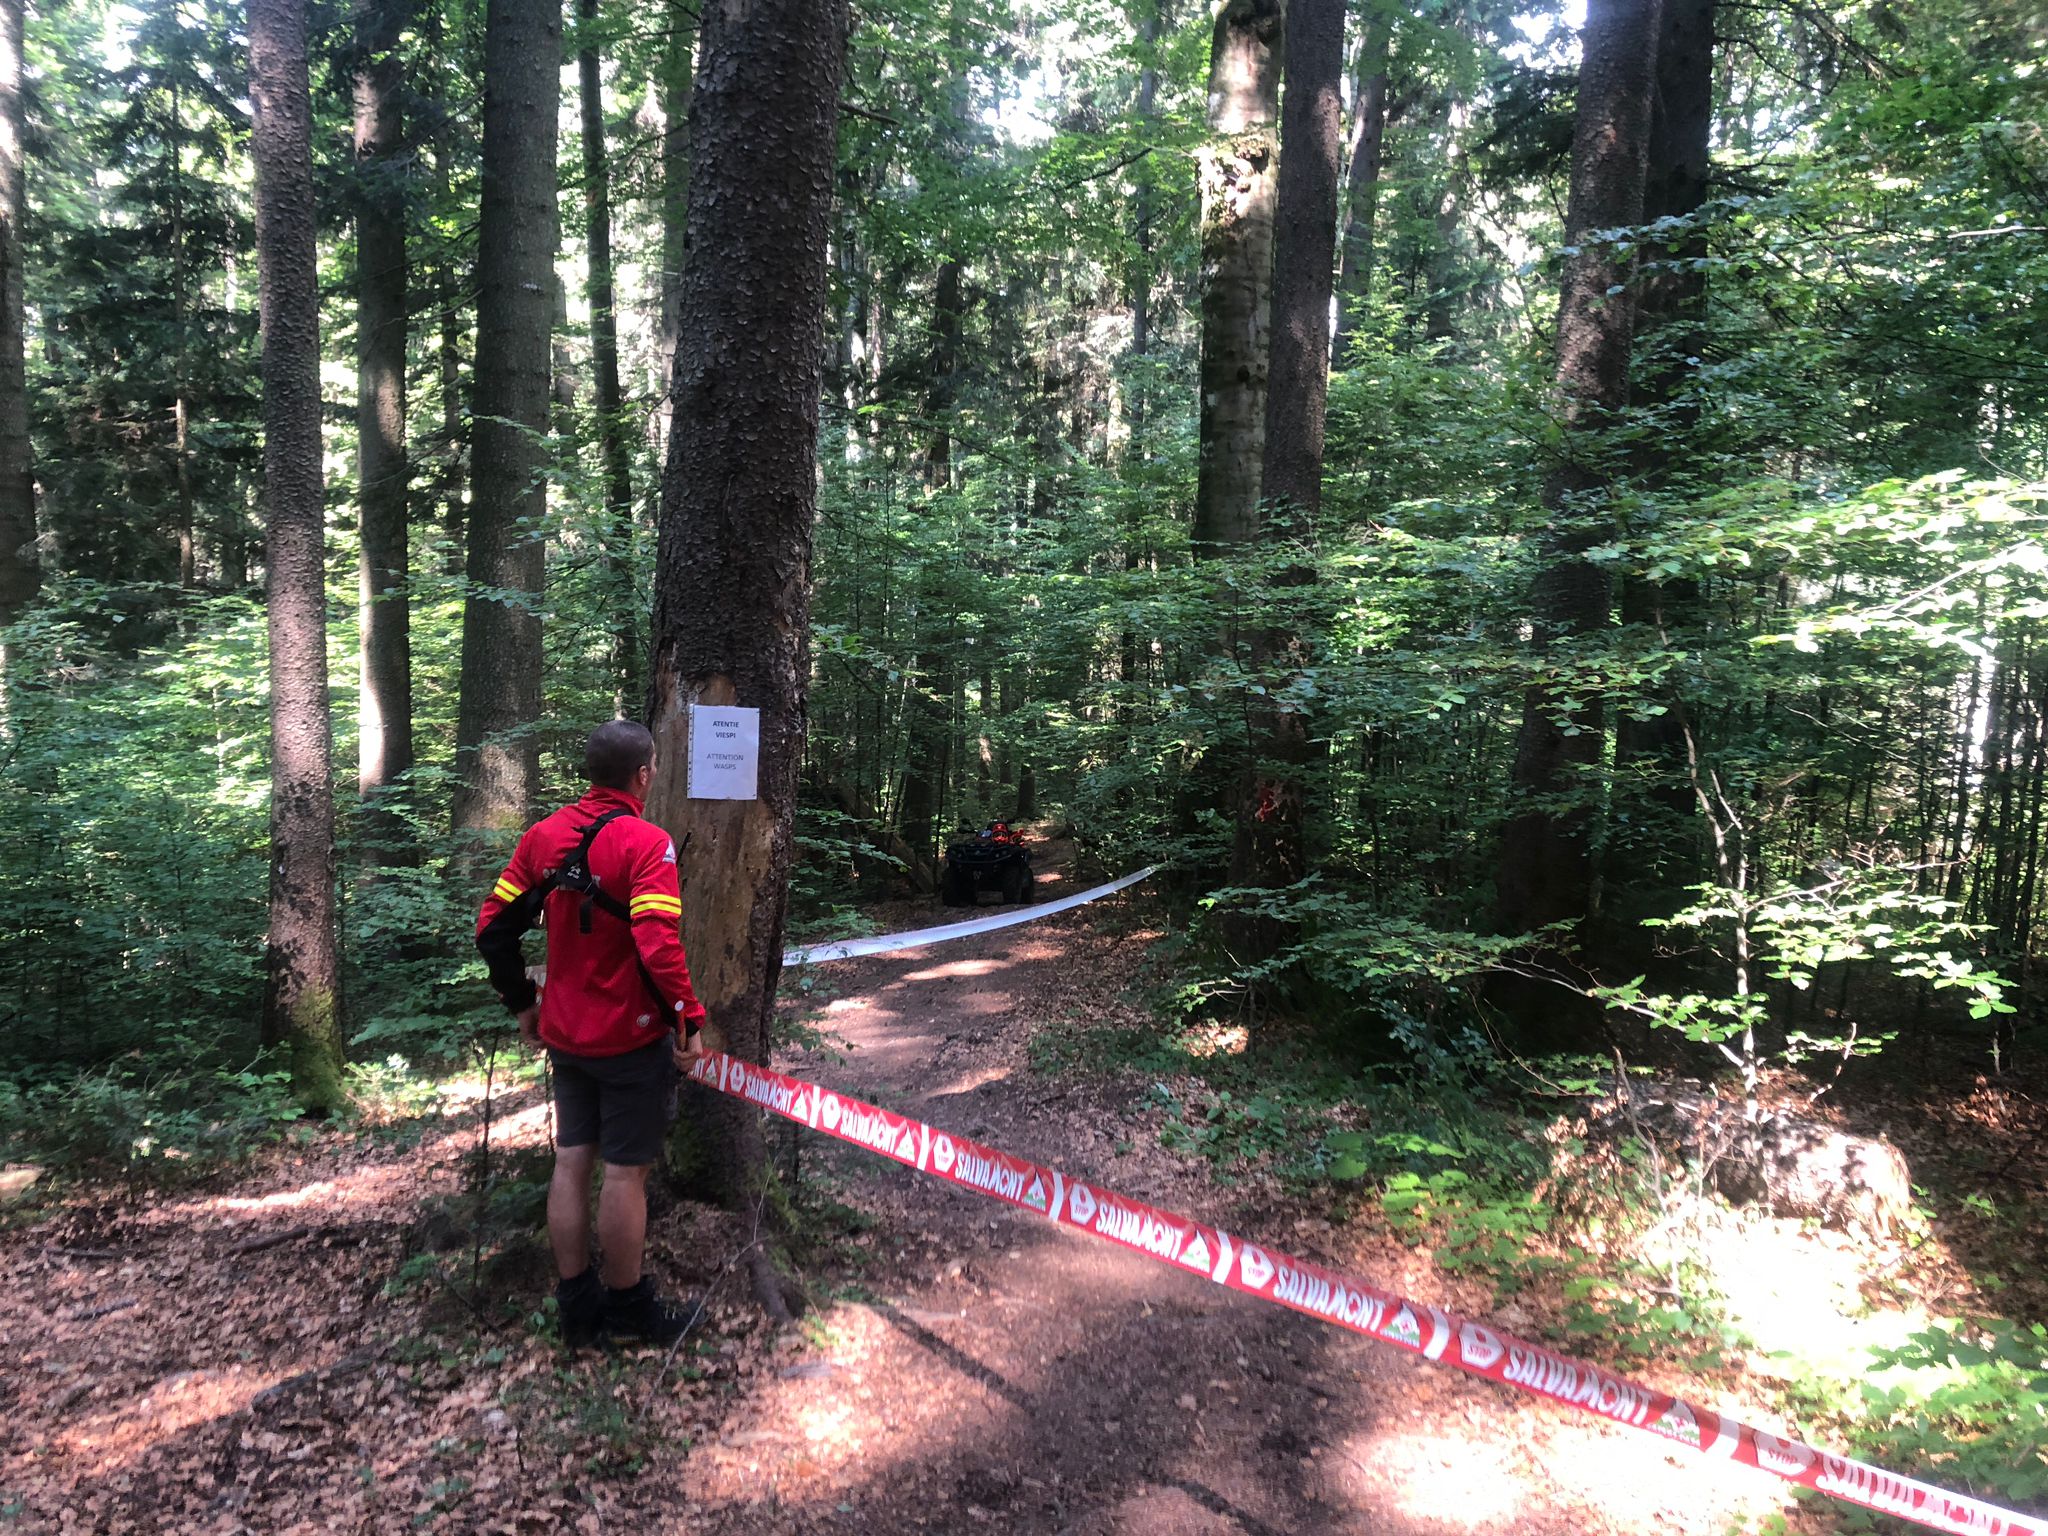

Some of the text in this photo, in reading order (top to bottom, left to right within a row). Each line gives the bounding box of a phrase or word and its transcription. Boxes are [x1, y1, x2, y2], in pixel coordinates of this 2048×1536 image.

[712, 720, 740, 728] ATENTIE
[706, 753, 744, 761] ATTENTION
[744, 1075, 795, 1114] SALVAMONT
[840, 1108, 899, 1155] SALVAMONT
[954, 1151, 1025, 1201] SALVAMONT
[1095, 1202, 1184, 1260] SALVAMONT
[1273, 1265, 1386, 1333] SALVAMONT
[1502, 1345, 1652, 1425] SALVAMONT
